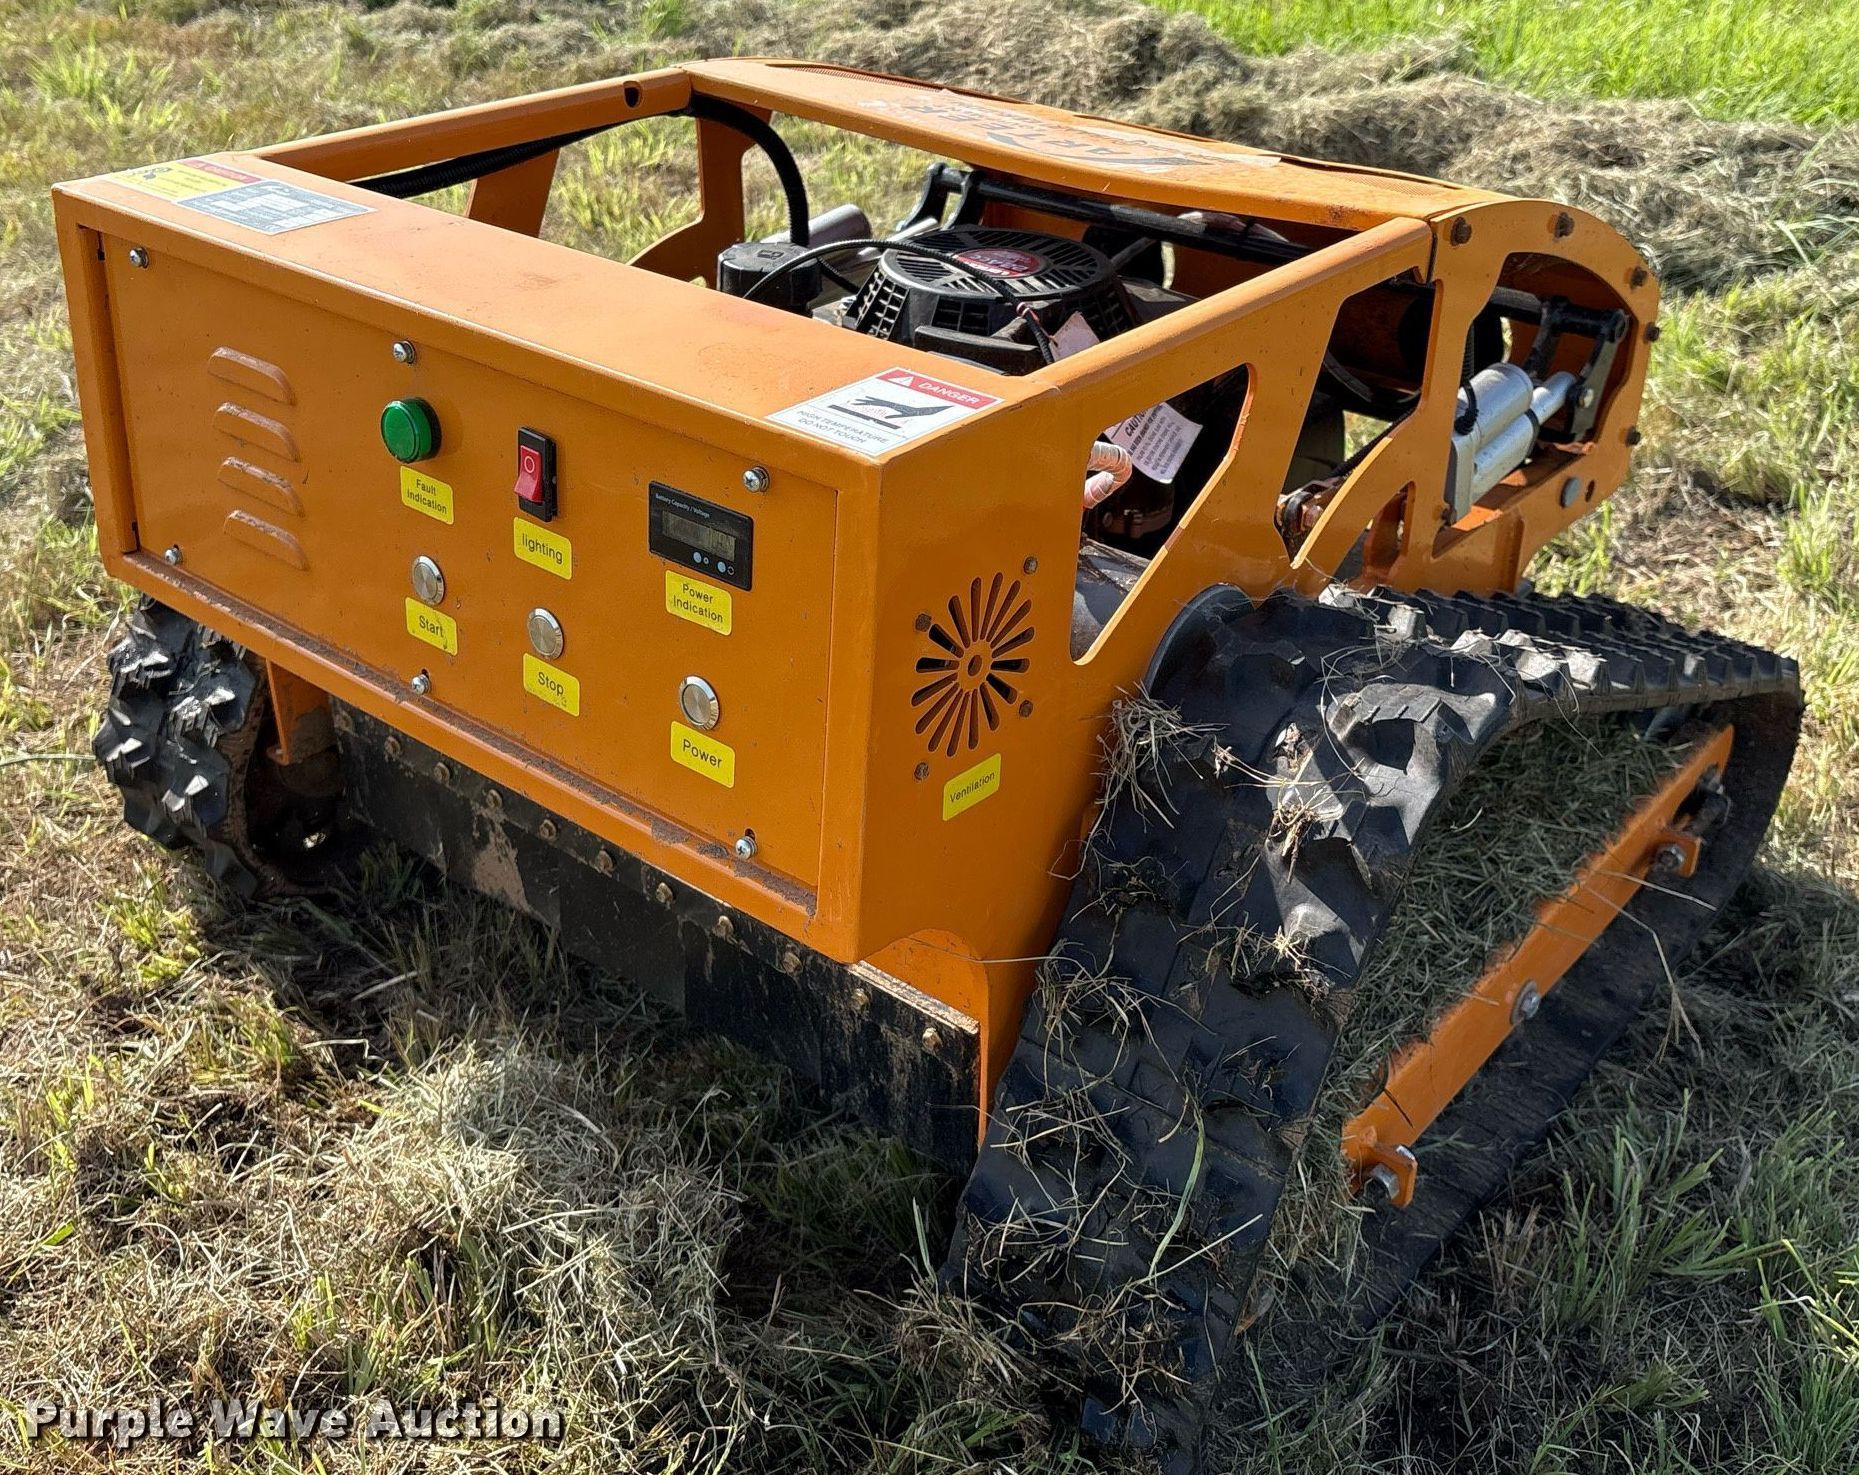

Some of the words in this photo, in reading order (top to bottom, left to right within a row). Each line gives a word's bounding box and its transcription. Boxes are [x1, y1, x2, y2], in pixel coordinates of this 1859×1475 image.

[918, 381, 982, 404] DANGER
[798, 418, 814, 426] DO
[815, 423, 836, 431] NOT
[834, 430, 867, 443] TOUCH
[822, 418, 890, 443] TEMPERATURE
[1124, 409, 1148, 438] CAUTI
[416, 479, 437, 496] Fault
[407, 489, 447, 515] Indication
[522, 532, 563, 565] lighting
[682, 582, 713, 604] Power
[673, 595, 724, 623] Indication
[418, 615, 444, 638] Start
[537, 671, 564, 697] Stop
[682, 738, 723, 769] Power
[949, 771, 996, 804] Ventilation
